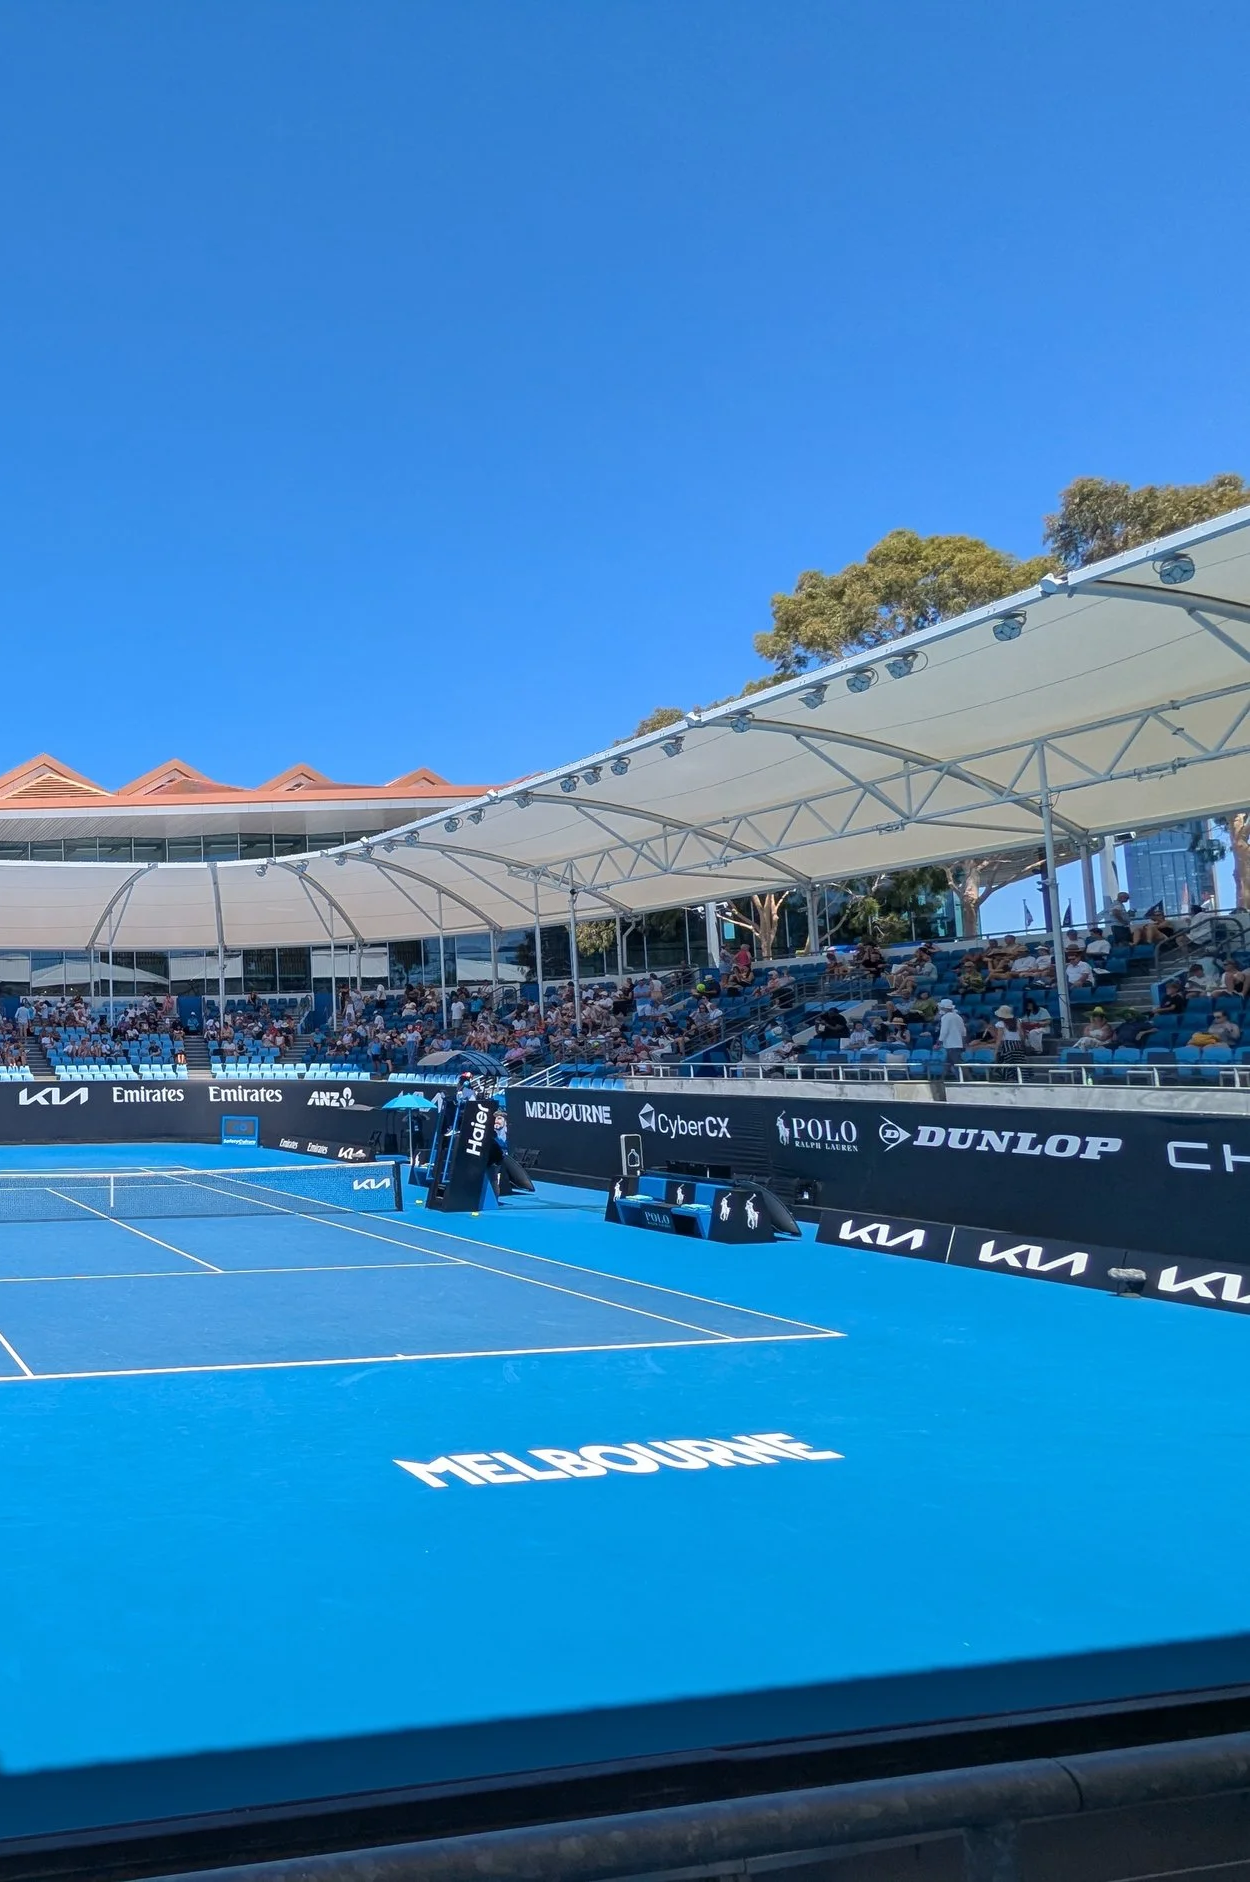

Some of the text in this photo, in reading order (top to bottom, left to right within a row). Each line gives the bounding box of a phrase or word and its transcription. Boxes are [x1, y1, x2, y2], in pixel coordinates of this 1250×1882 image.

[19, 1087, 88, 1106] KIA
[112, 1086, 185, 1103] Emirates
[208, 1085, 283, 1103] Emirates
[307, 1090, 340, 1107] ANZ
[525, 1101, 612, 1125] MELBOURNE
[466, 1103, 490, 1157] Haier
[657, 1113, 732, 1139] CyberCX
[791, 1117, 858, 1143] POLO
[307, 1142, 328, 1155] Emirates
[795, 1140, 859, 1153] RALPH LAUREN
[913, 1125, 1123, 1160] DUNLOP
[353, 1177, 391, 1191] KIA
[644, 1211, 670, 1225] POLO
[839, 1219, 926, 1251] KIA
[978, 1239, 1089, 1277] KIA
[392, 1432, 846, 1488] MELBOURNE
